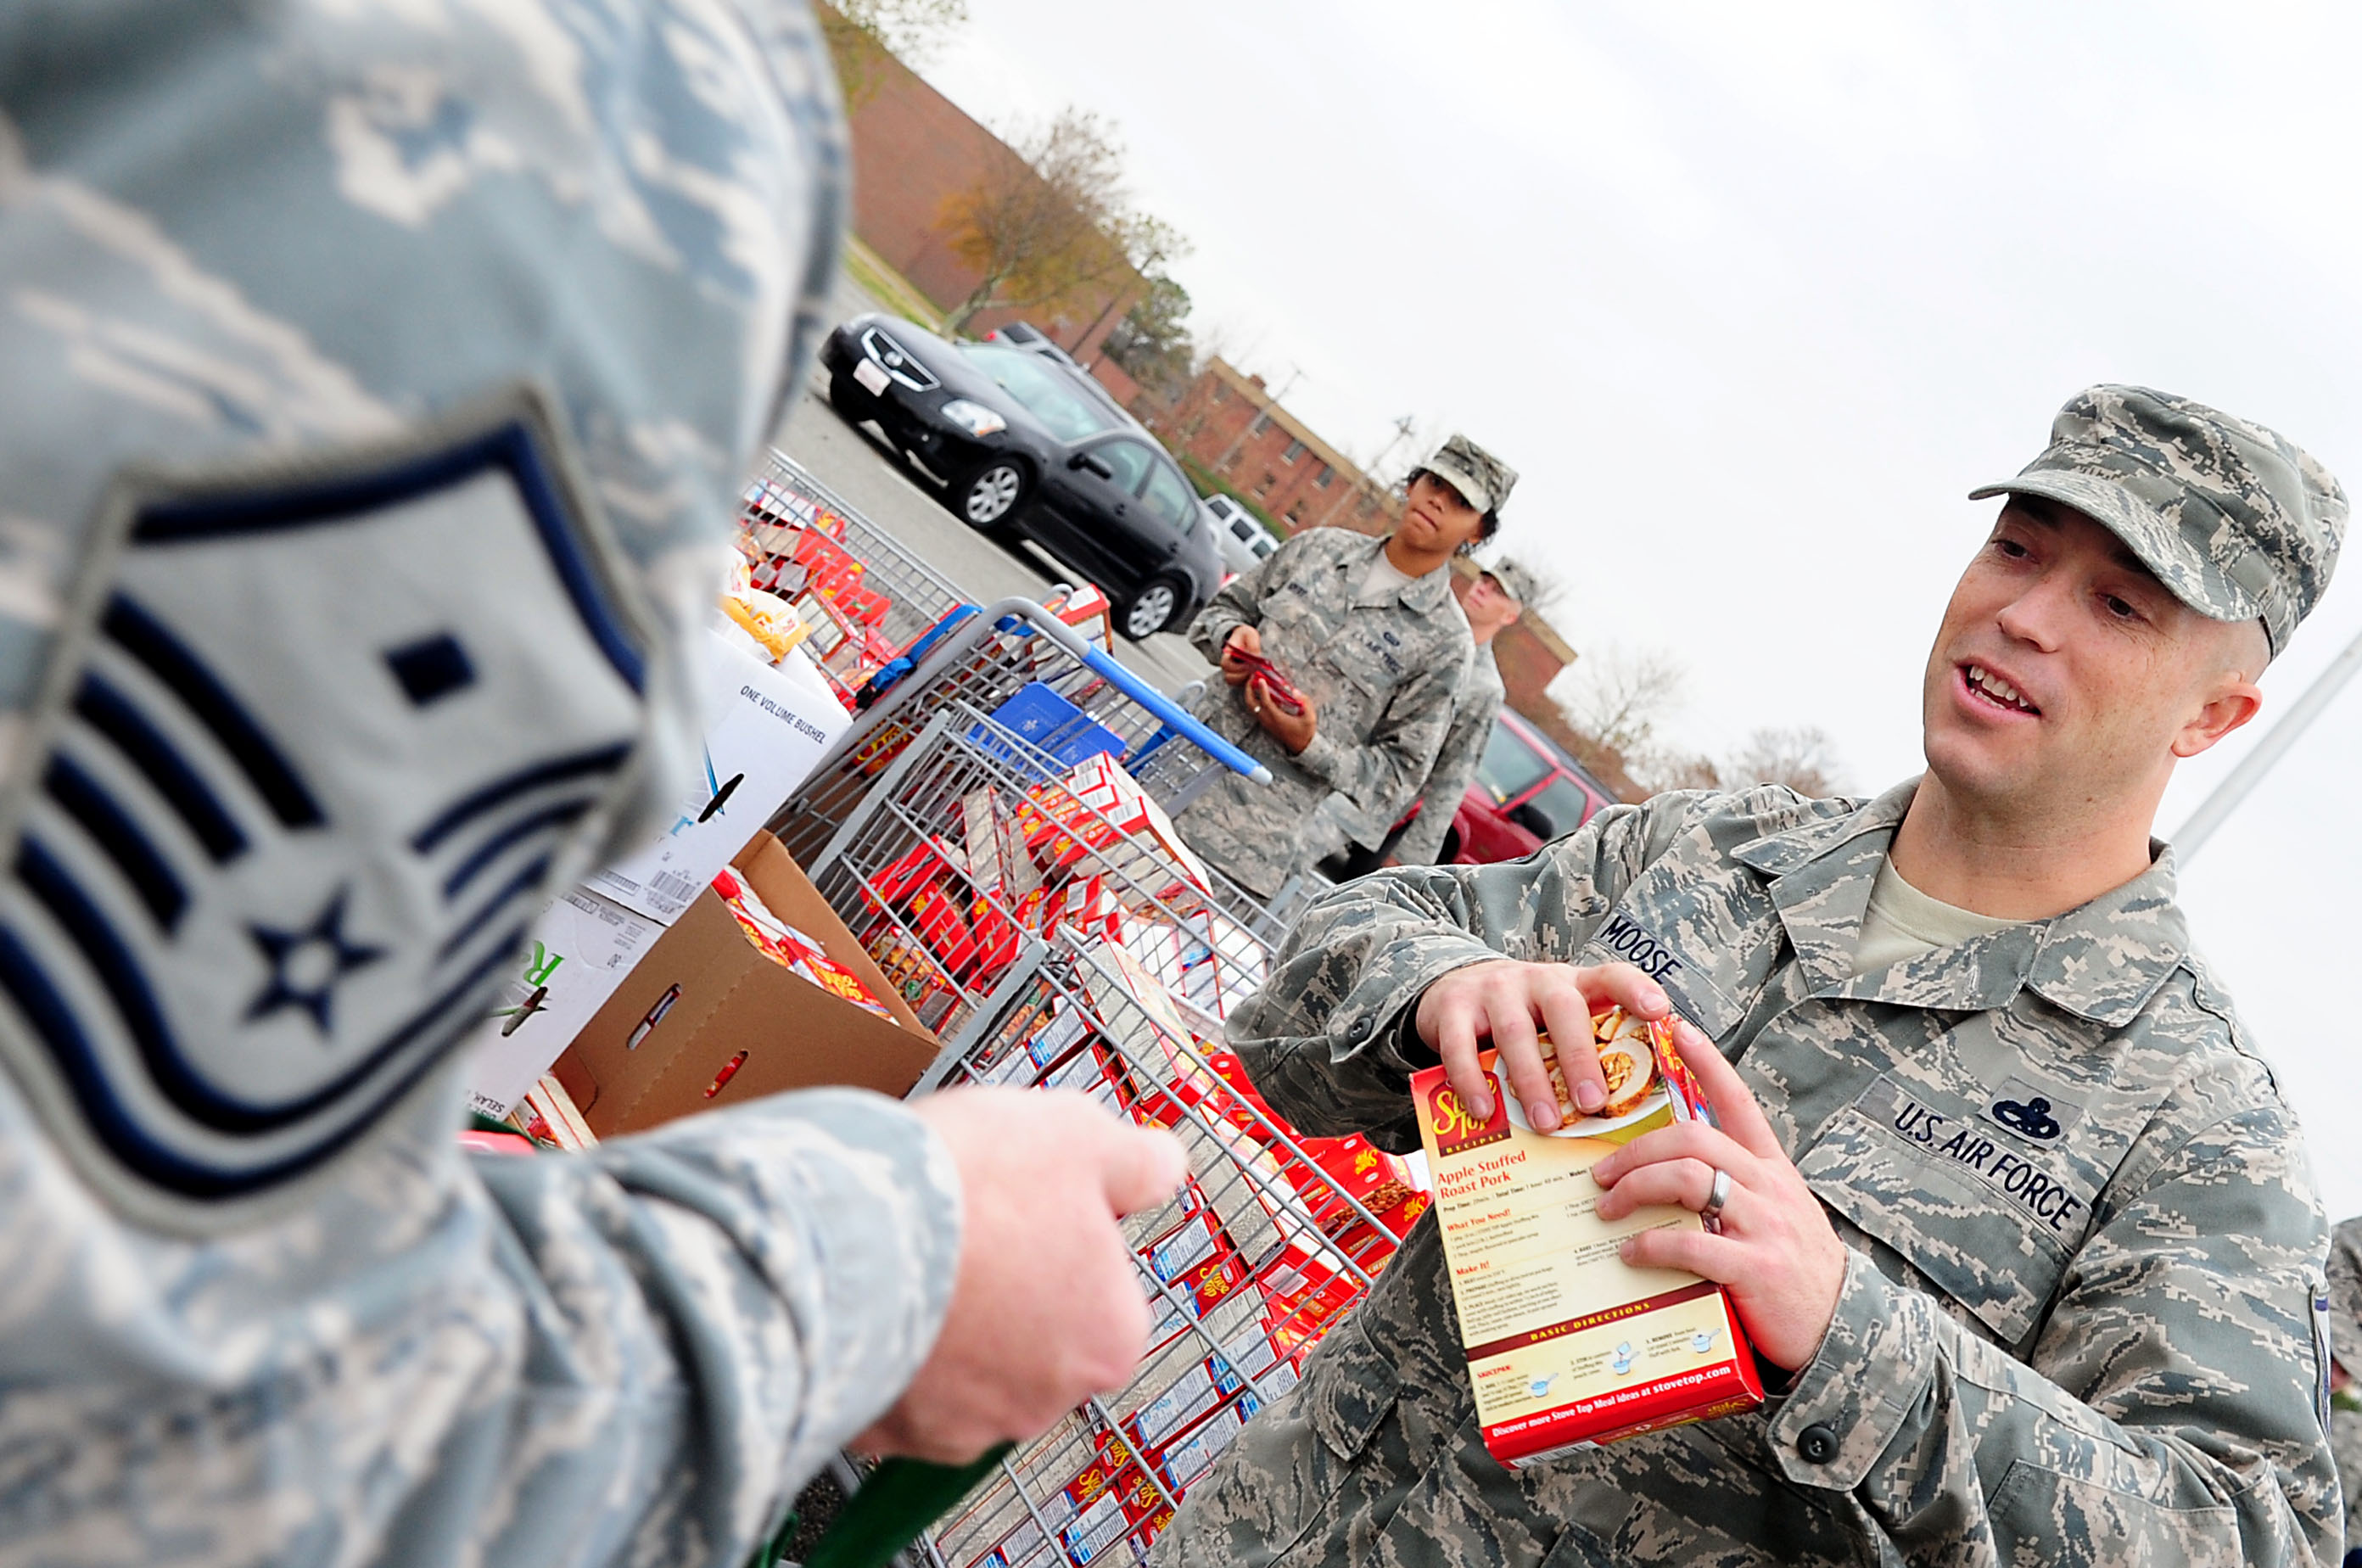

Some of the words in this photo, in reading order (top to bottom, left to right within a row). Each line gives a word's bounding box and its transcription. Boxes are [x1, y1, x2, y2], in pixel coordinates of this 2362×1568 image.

[740, 685, 761, 703] ONE
[759, 697, 797, 725] VOLUME
[793, 718, 826, 745] BUSHEL
[1599, 915, 1683, 985] MOOSE
[1446, 1133, 1504, 1154] RECIPES
[1437, 1166, 1475, 1185] Apple
[1478, 1150, 1527, 1173] Stuffed
[1894, 1101, 1944, 1148] U.S.
[1938, 1129, 1995, 1170] AIR
[1987, 1152, 2082, 1232] FORCE
[1440, 1180, 1477, 1200] Roast
[1480, 1171, 1512, 1189] Pork
[1447, 1219, 1469, 1232] What
[1470, 1216, 1486, 1227] You
[1456, 1264, 1479, 1275] Make
[1530, 1324, 1568, 1341] BASIC
[1572, 1302, 1651, 1330] DIRECTIONS
[1491, 1421, 1528, 1438] Discover
[1528, 1414, 1553, 1427] more
[1551, 1408, 1576, 1422] Stove
[1576, 1403, 1594, 1415] Top
[1592, 1395, 1617, 1410] Meal
[1617, 1390, 1641, 1403] ideas
[1641, 1386, 1652, 1397] at
[1652, 1365, 1732, 1394] stovetop.com
